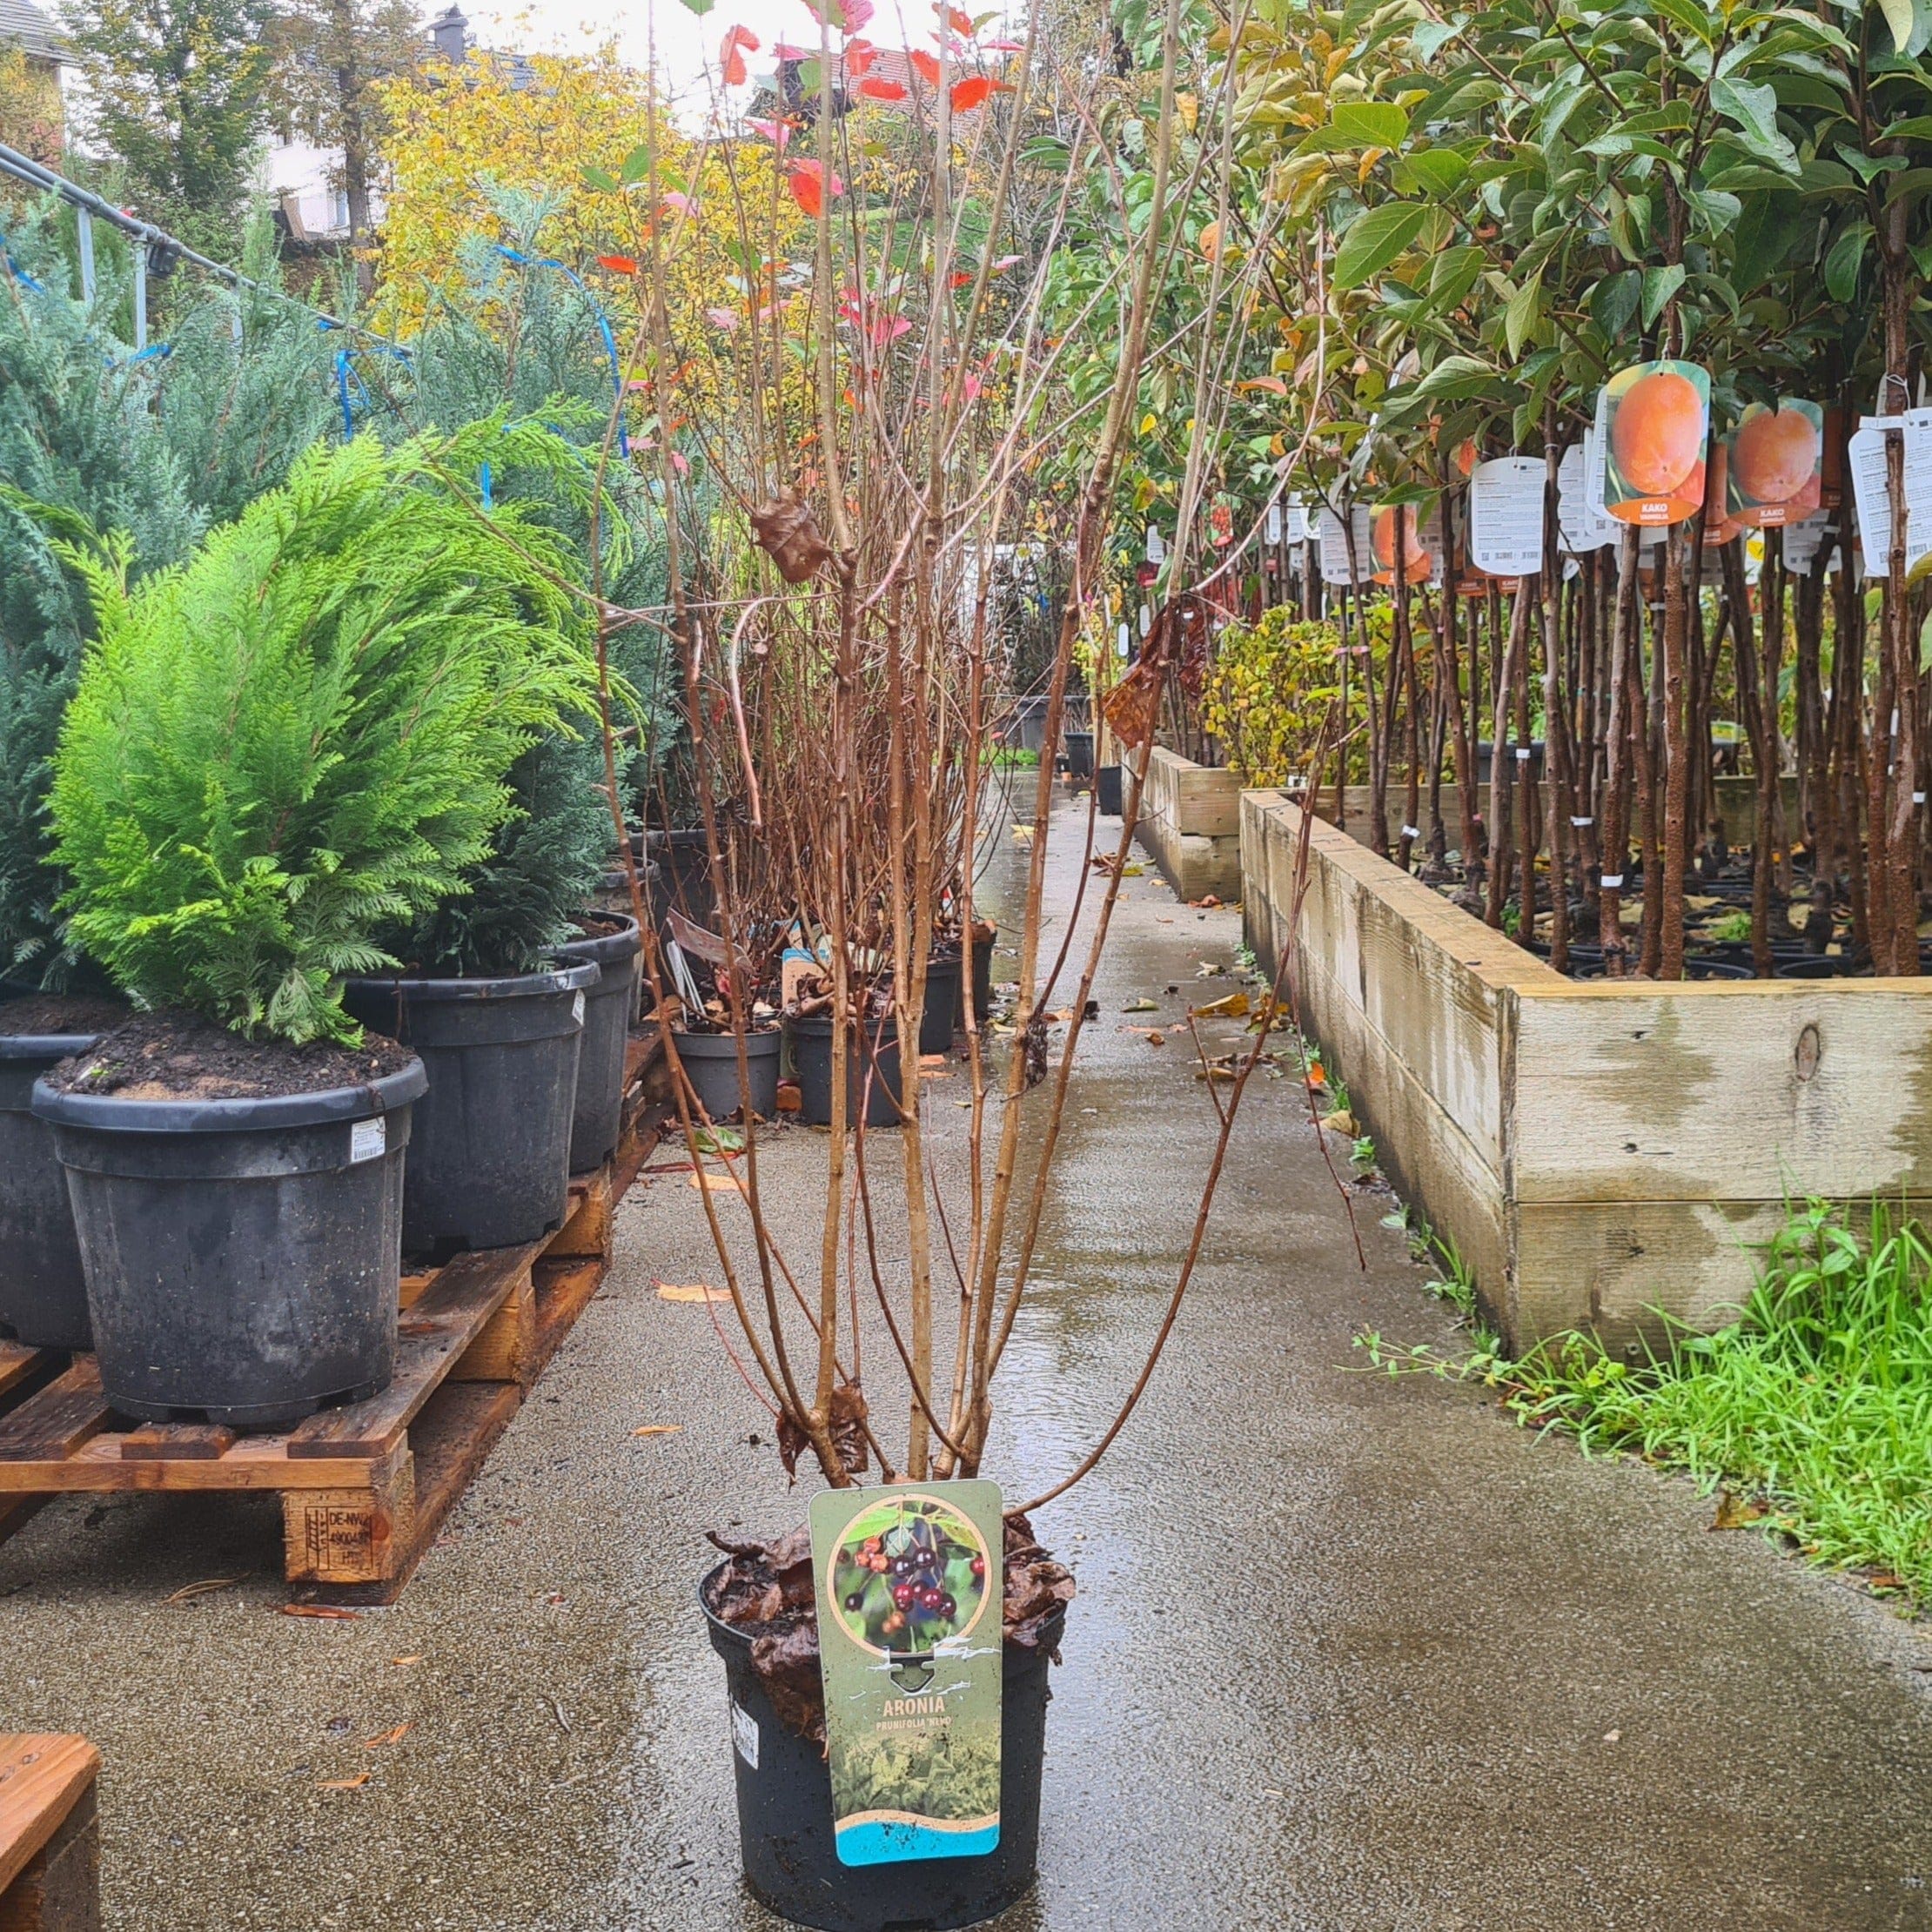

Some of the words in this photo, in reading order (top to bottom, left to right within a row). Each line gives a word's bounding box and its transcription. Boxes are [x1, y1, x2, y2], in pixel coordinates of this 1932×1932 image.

[1641, 502, 1668, 513] KAKO
[1760, 508, 1785, 519] KAKO
[882, 1695, 945, 1716] ARONIA
[875, 1718, 925, 1731] PRUNIFOLIA
